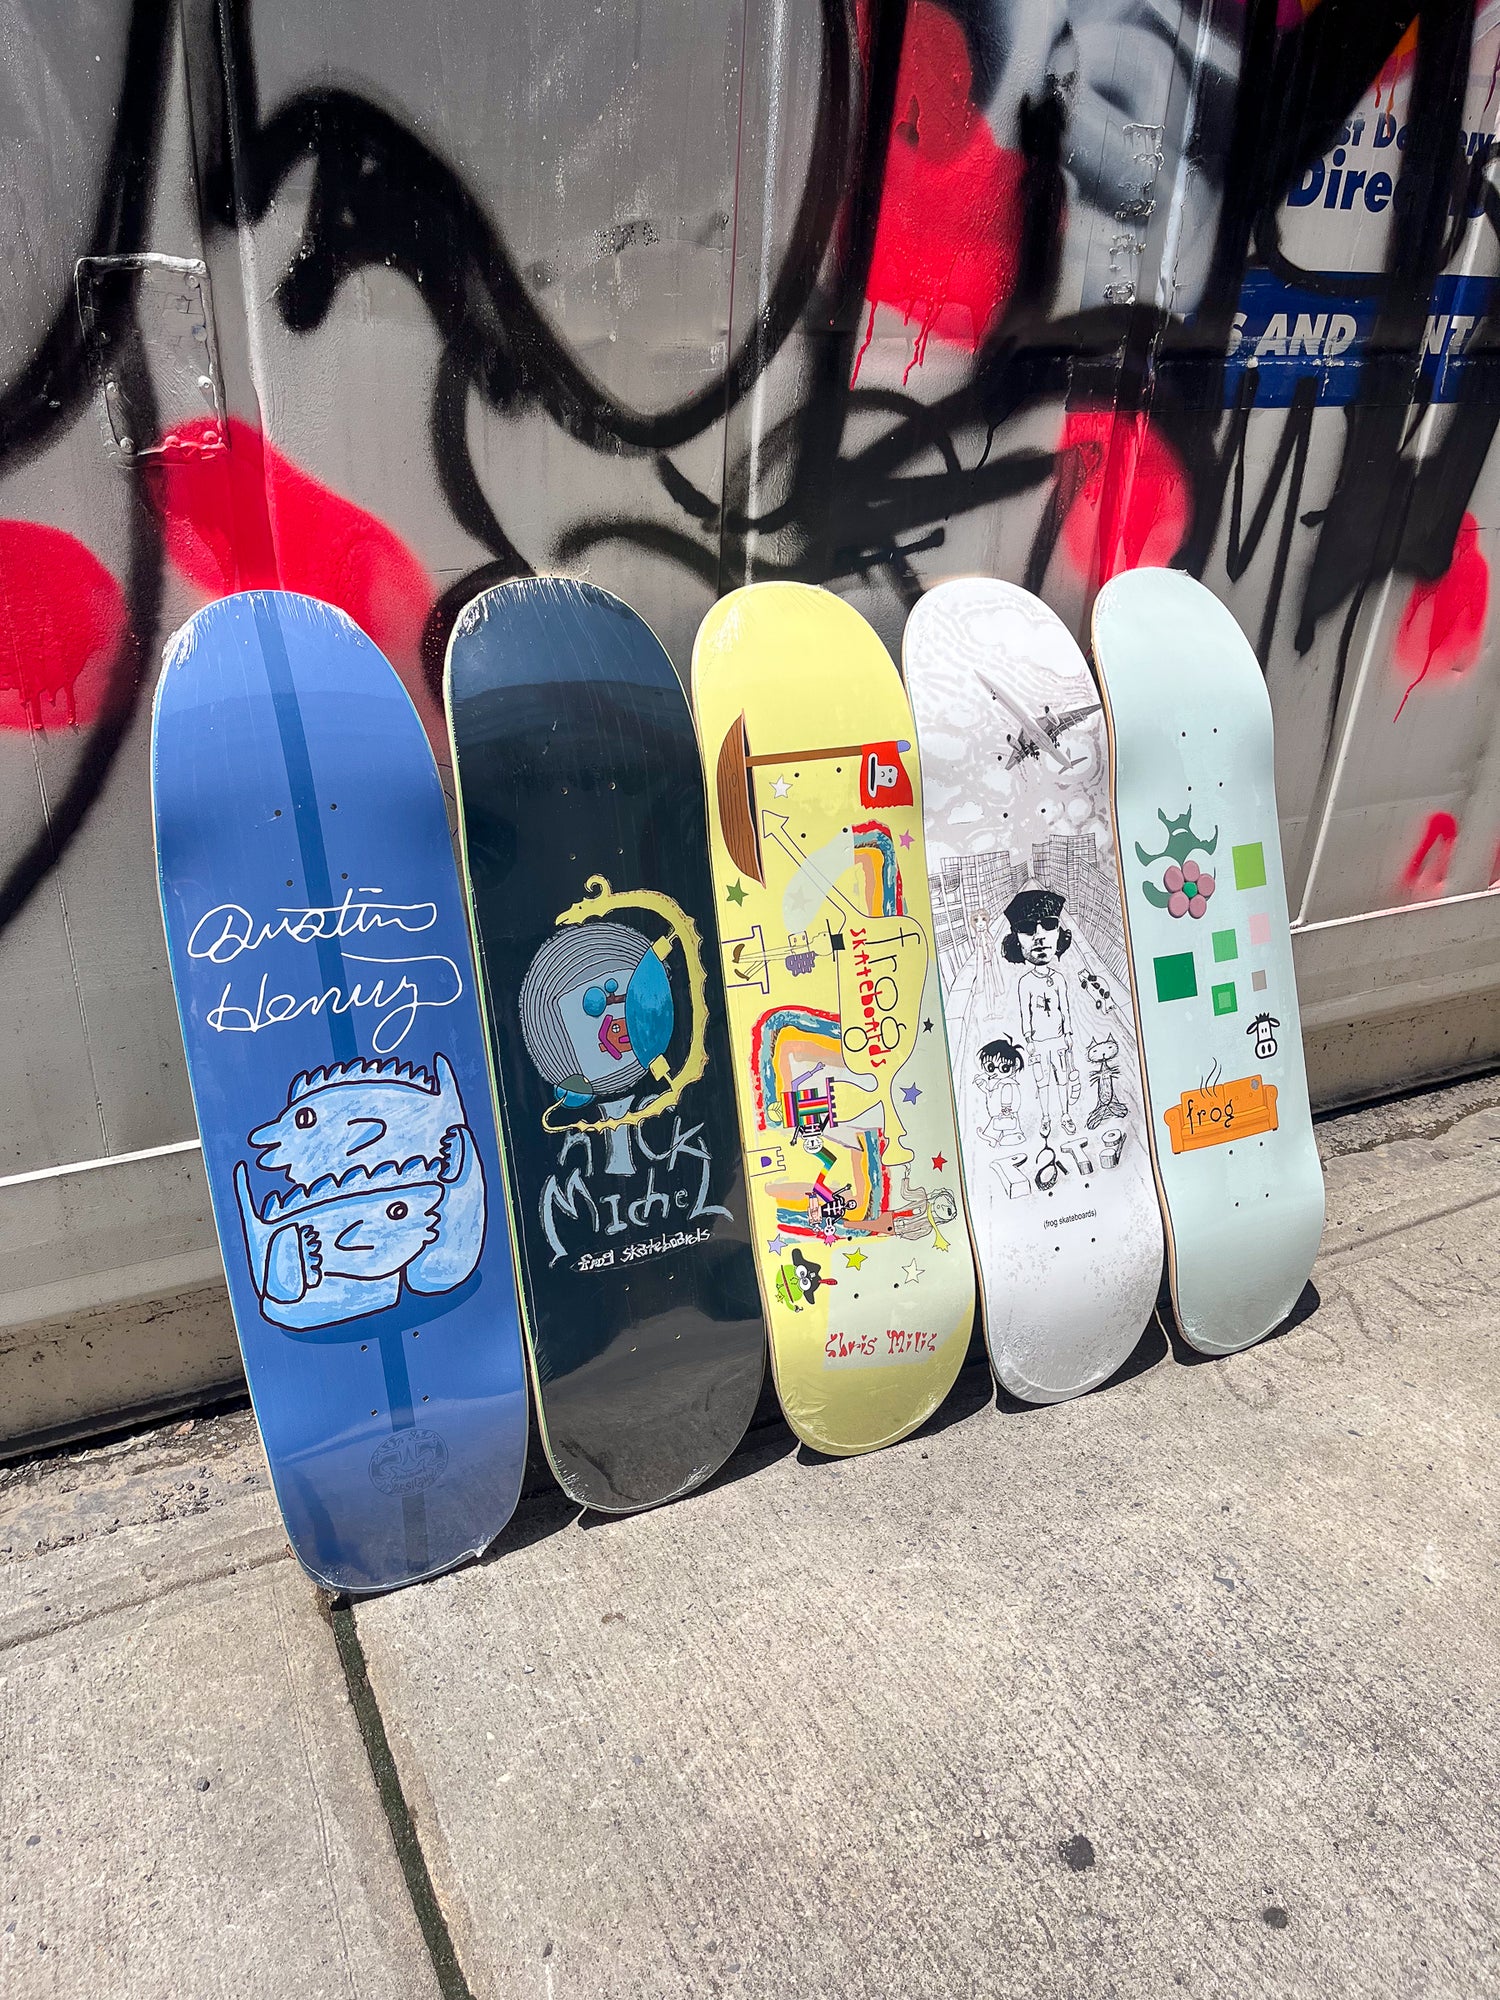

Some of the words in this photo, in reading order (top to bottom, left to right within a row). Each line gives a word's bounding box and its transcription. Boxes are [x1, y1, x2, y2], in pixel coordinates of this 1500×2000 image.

[1253, 313, 1358, 357] AND
[205, 952, 463, 1055] Henry
[843, 926, 921, 1053] frog
[1186, 1098, 1235, 1135] frog
